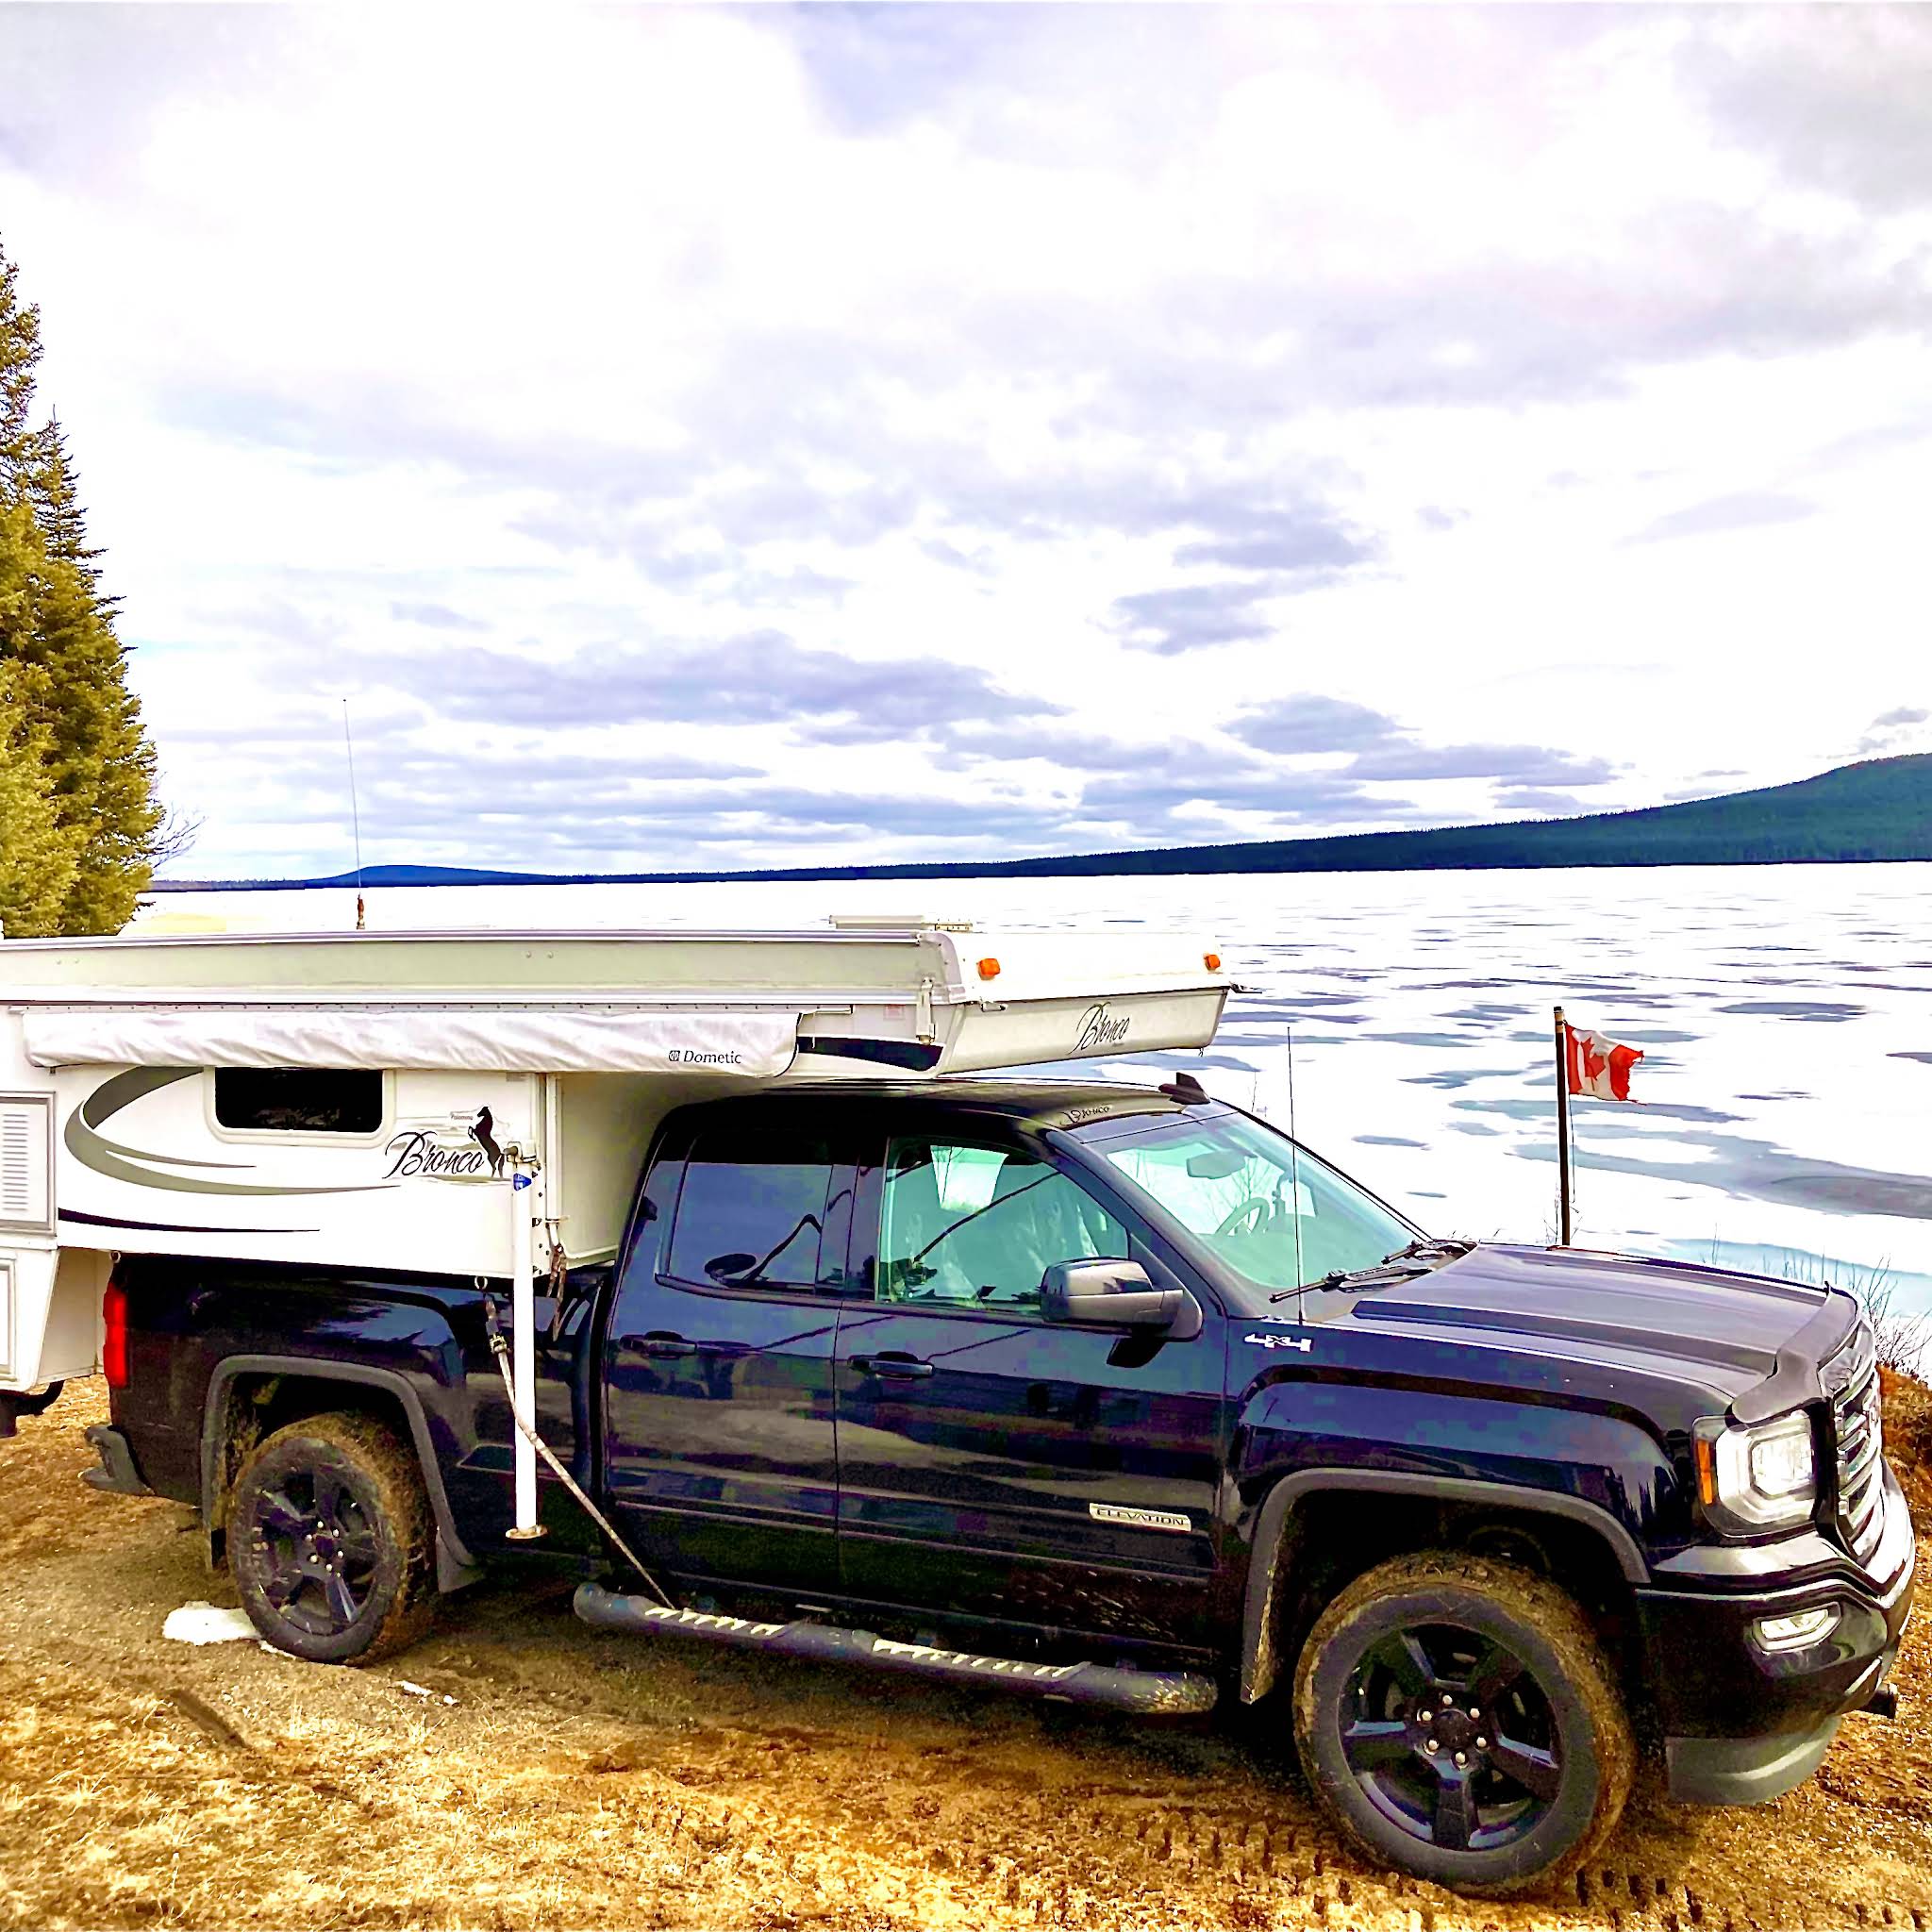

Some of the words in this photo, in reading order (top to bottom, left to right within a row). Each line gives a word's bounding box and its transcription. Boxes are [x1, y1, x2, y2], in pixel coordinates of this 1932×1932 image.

[1066, 1002, 1130, 1055] Bronco
[684, 1050, 742, 1064] Dometic
[381, 1131, 485, 1179] Bronco
[1096, 1508, 1184, 1526] ELEVATION
